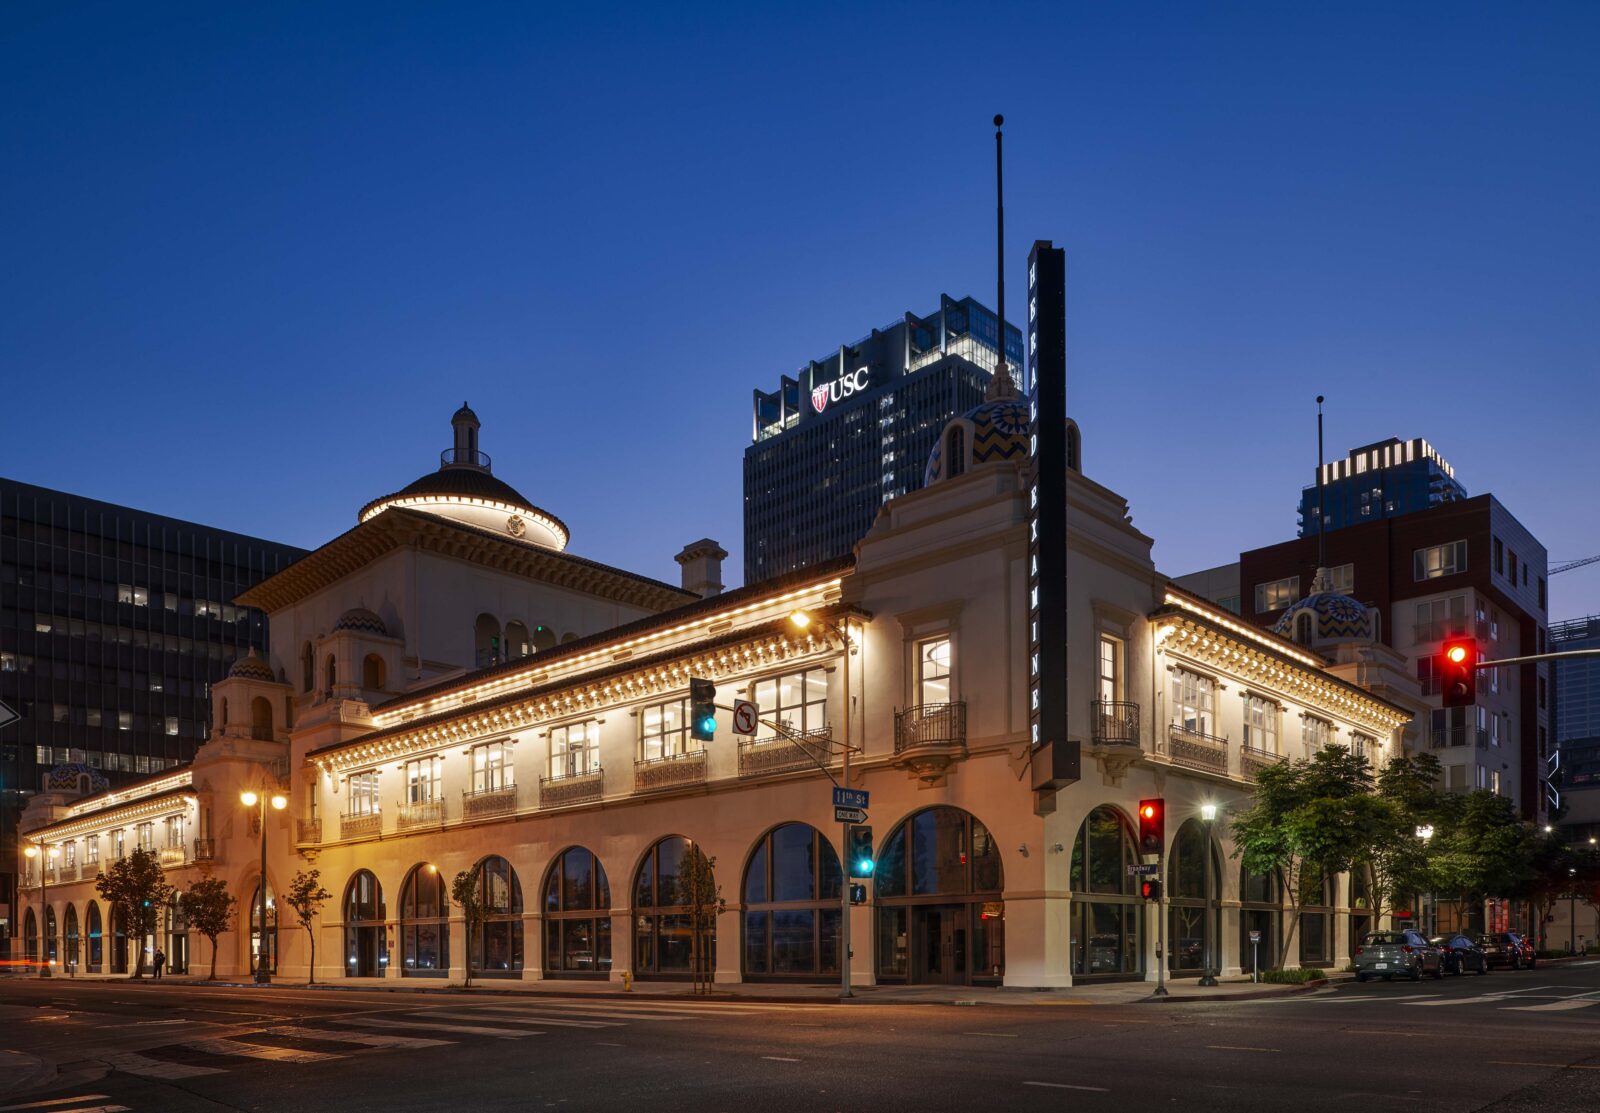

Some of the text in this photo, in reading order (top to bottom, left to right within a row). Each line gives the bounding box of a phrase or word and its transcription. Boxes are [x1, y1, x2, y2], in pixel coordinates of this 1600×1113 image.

[829, 366, 869, 402] USC
[1029, 261, 1039, 744] HERALD EXAMINER
[836, 791, 866, 805] 11th St
[1127, 865, 1151, 873] Broadway
